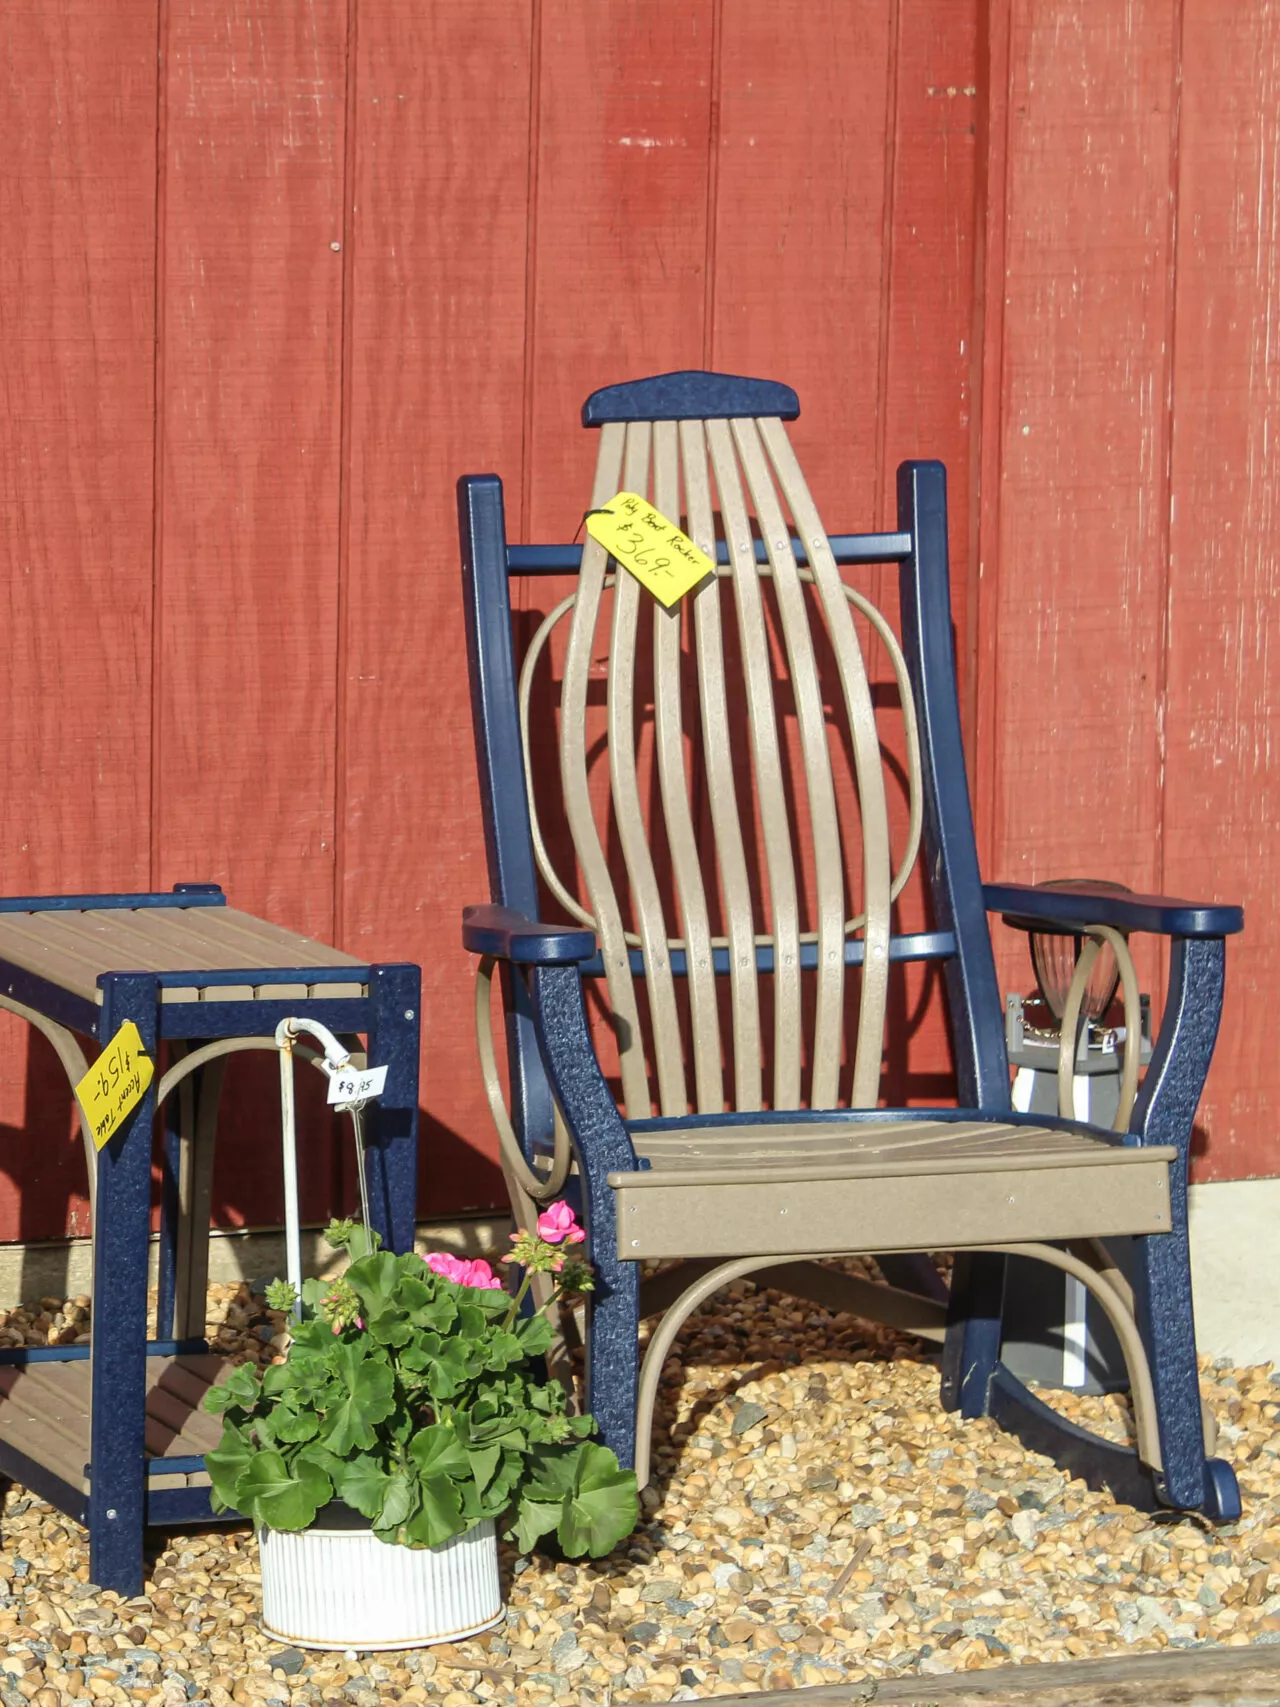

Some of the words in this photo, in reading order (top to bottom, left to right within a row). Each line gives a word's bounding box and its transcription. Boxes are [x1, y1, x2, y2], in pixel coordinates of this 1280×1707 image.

[666, 536, 700, 565] Rocker
[117, 1071, 140, 1112] Accent
[96, 1108, 117, 1137] Table
